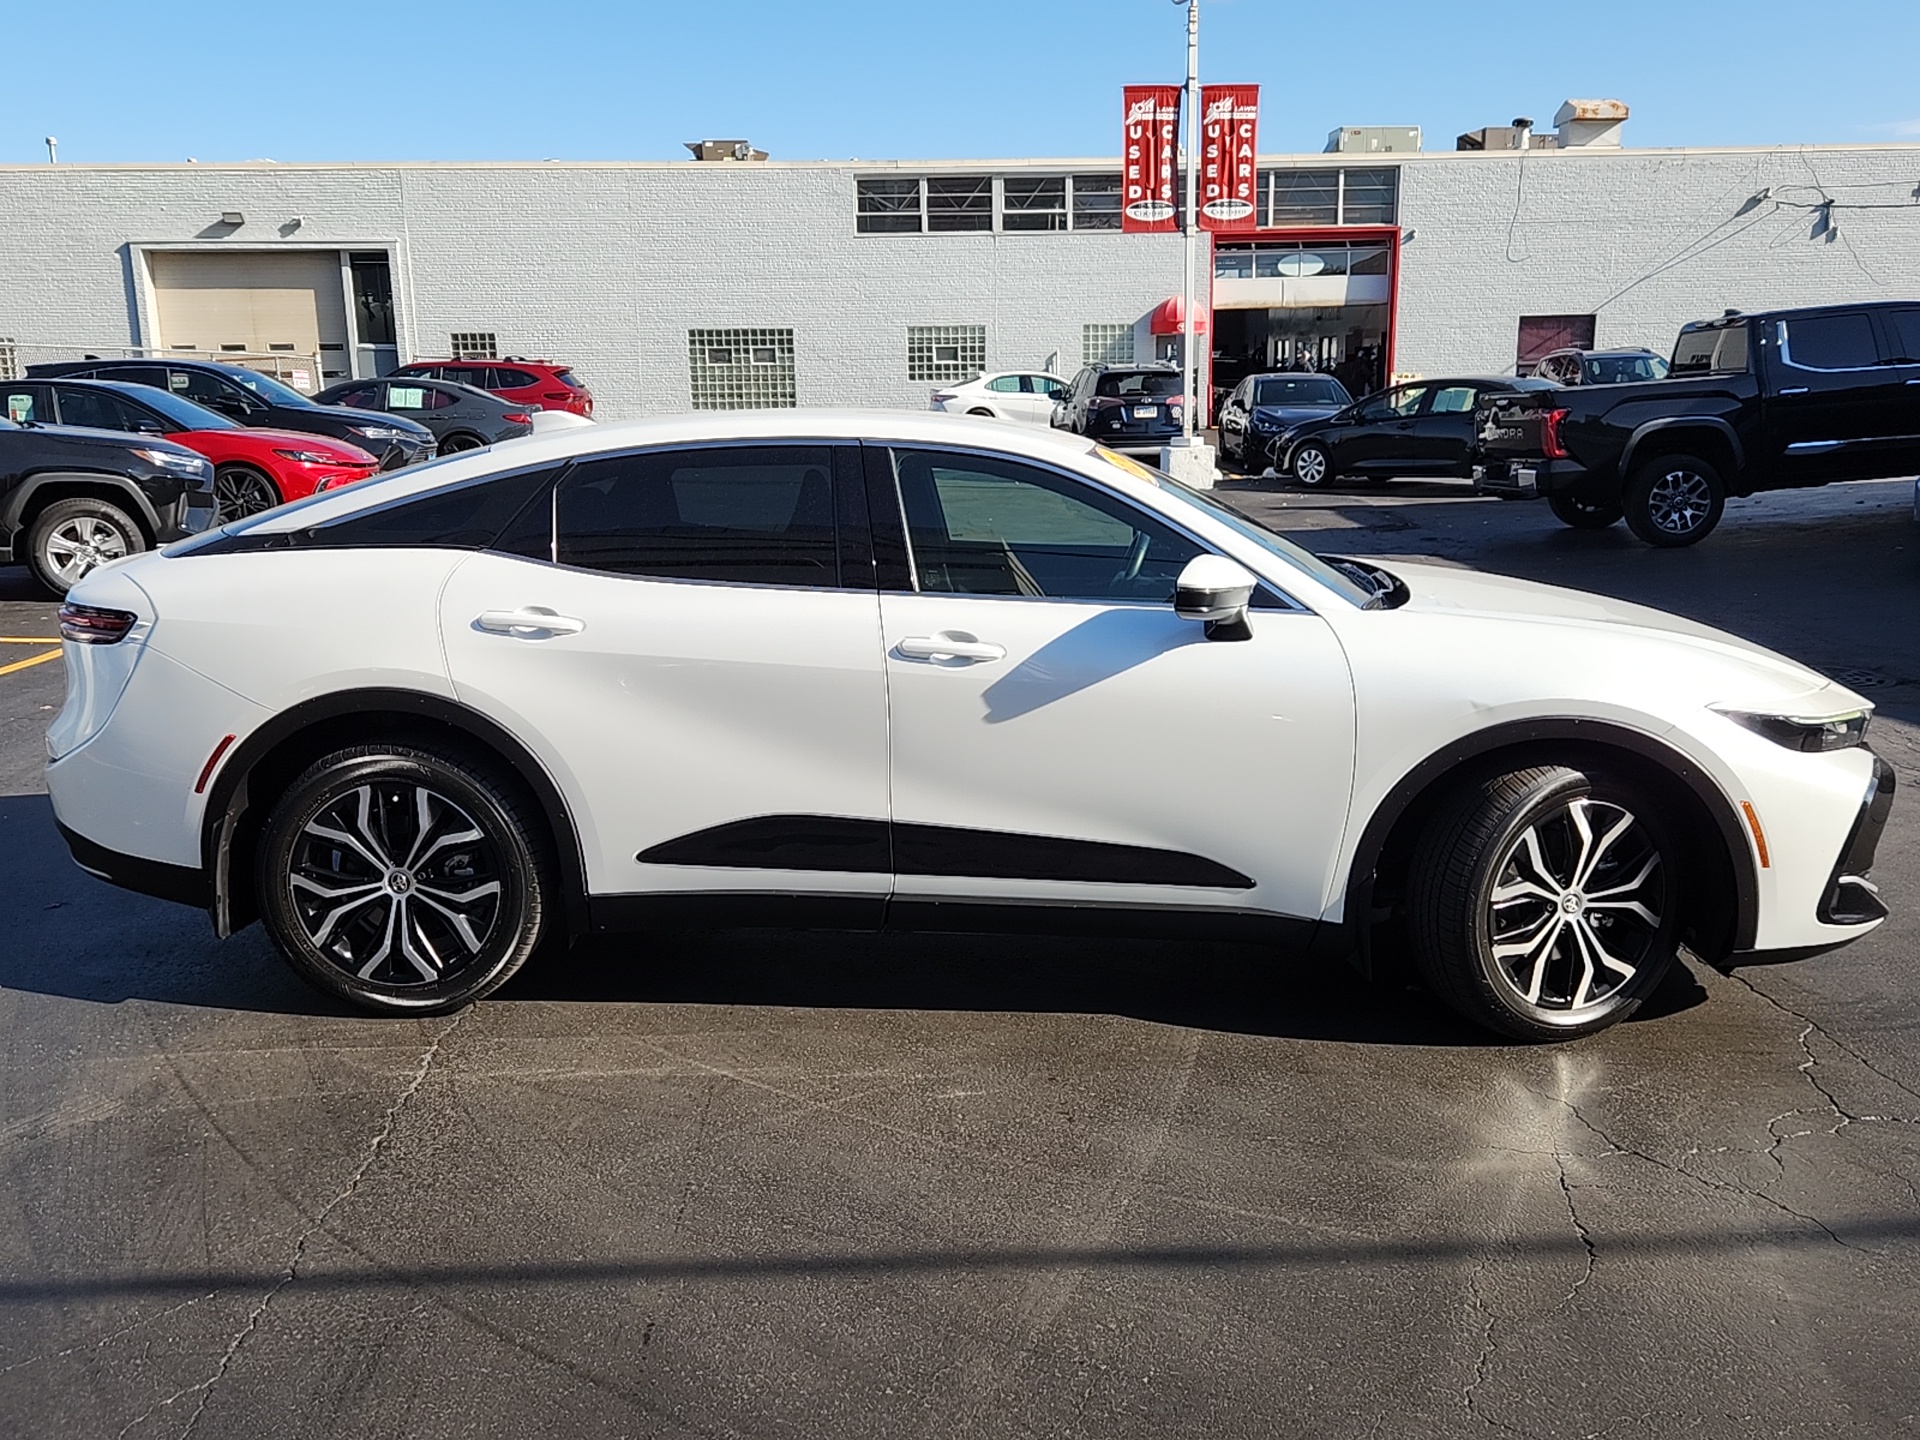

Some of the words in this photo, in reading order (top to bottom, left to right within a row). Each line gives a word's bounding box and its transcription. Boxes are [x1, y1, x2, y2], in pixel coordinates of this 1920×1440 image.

[1129, 125, 1142, 198] USED
[1161, 125, 1173, 199] CARS
[1206, 124, 1220, 197] USED
[1238, 124, 1252, 197] CARS
